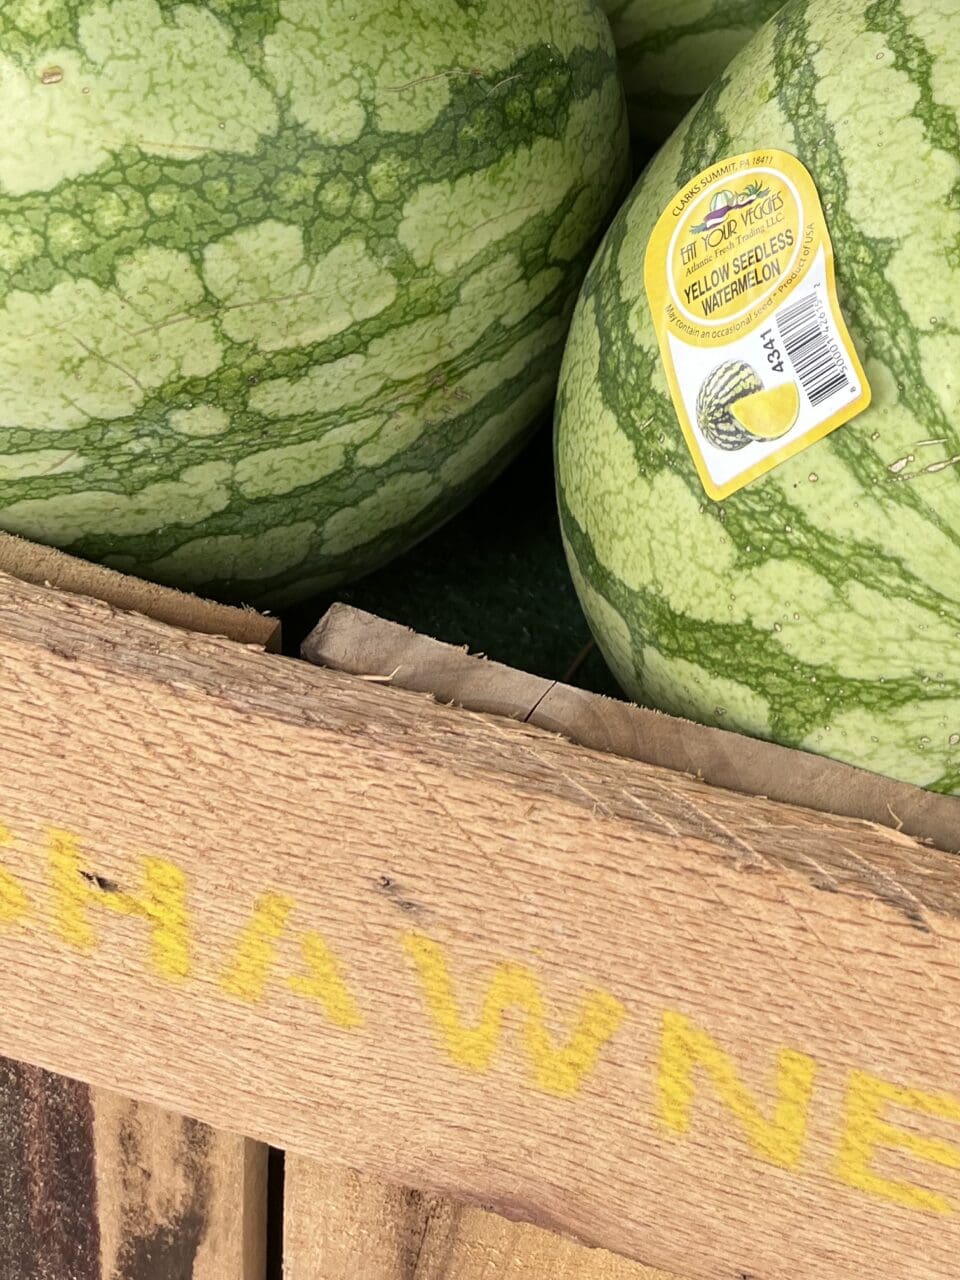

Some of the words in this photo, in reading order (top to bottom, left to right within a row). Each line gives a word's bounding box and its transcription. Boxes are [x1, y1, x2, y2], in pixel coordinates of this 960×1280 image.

[672, 184, 701, 218] CLARKS
[700, 162, 738, 188] SUMMIT,
[739, 158, 750, 167] PA
[752, 155, 774, 166] 18411
[680, 241, 698, 266] EAT
[702, 219, 738, 252] YOUR
[741, 191, 785, 226] VEGGIES
[805, 222, 815, 245] USA
[684, 263, 730, 304] YELLOW
[732, 228, 794, 275] SEEDLESS
[686, 254, 713, 277] Atlantic
[715, 240, 735, 258] Fresh
[736, 225, 765, 245] Trading
[802, 246, 811, 256] of
[701, 258, 781, 316] WATERMELON
[778, 258, 807, 293] Product
[665, 303, 678, 323] May
[753, 298, 774, 319] seed
[675, 319, 700, 337] contain
[700, 330, 711, 339] an
[711, 313, 753, 339] occasional
[760, 328, 784, 372] 4341
